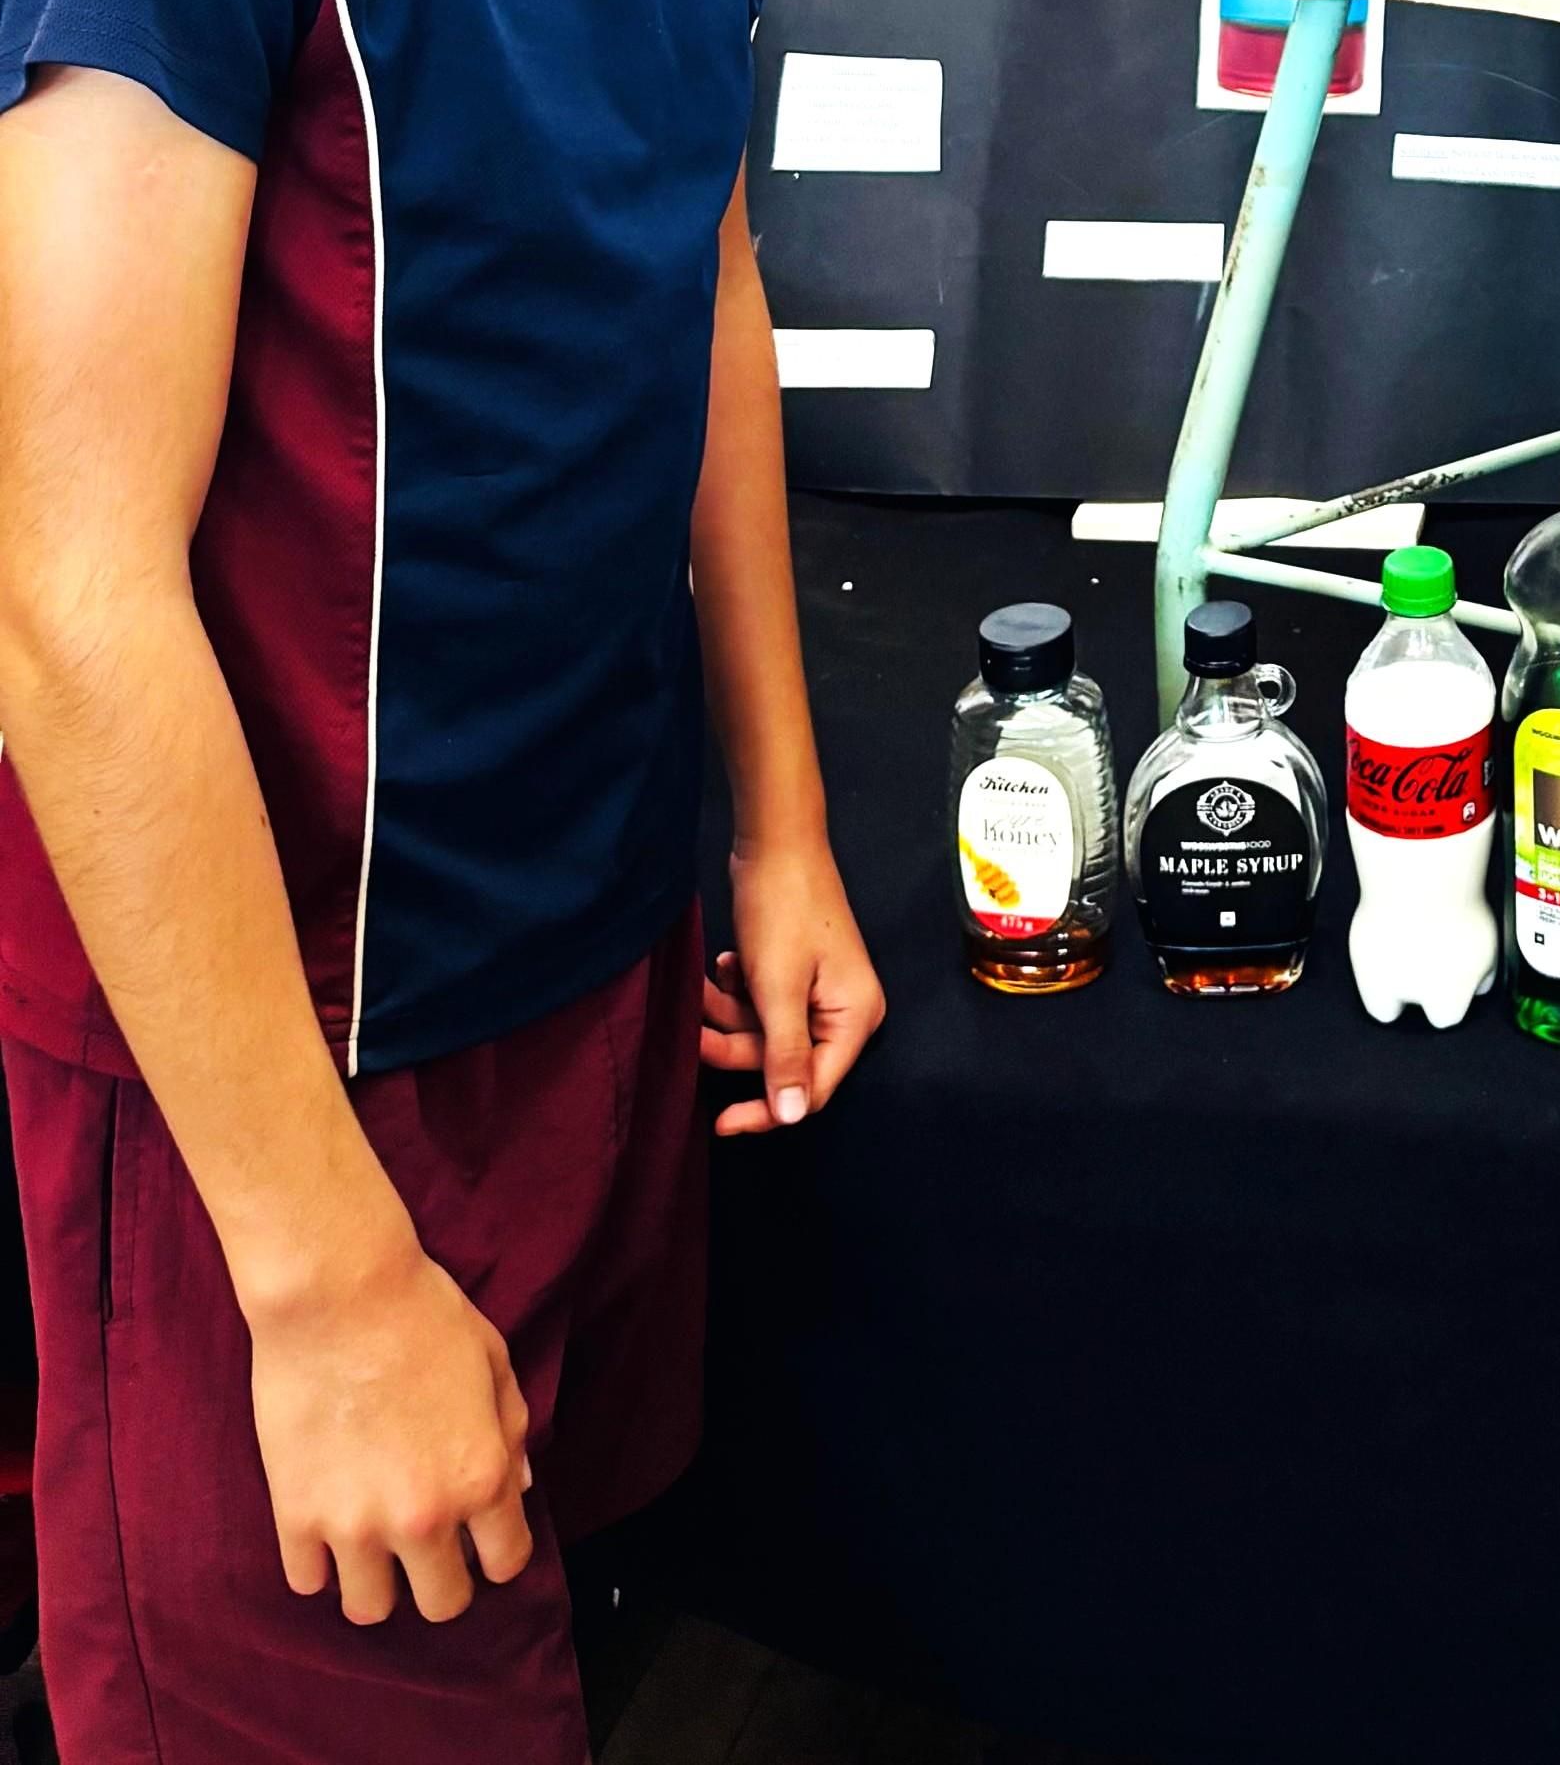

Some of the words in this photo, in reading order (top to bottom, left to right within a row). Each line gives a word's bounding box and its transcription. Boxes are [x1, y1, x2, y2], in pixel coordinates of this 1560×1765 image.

[980, 776, 1050, 795] Kitchen
[1159, 856, 1230, 875] MAPLE
[1236, 853, 1303, 875] SYRUP
